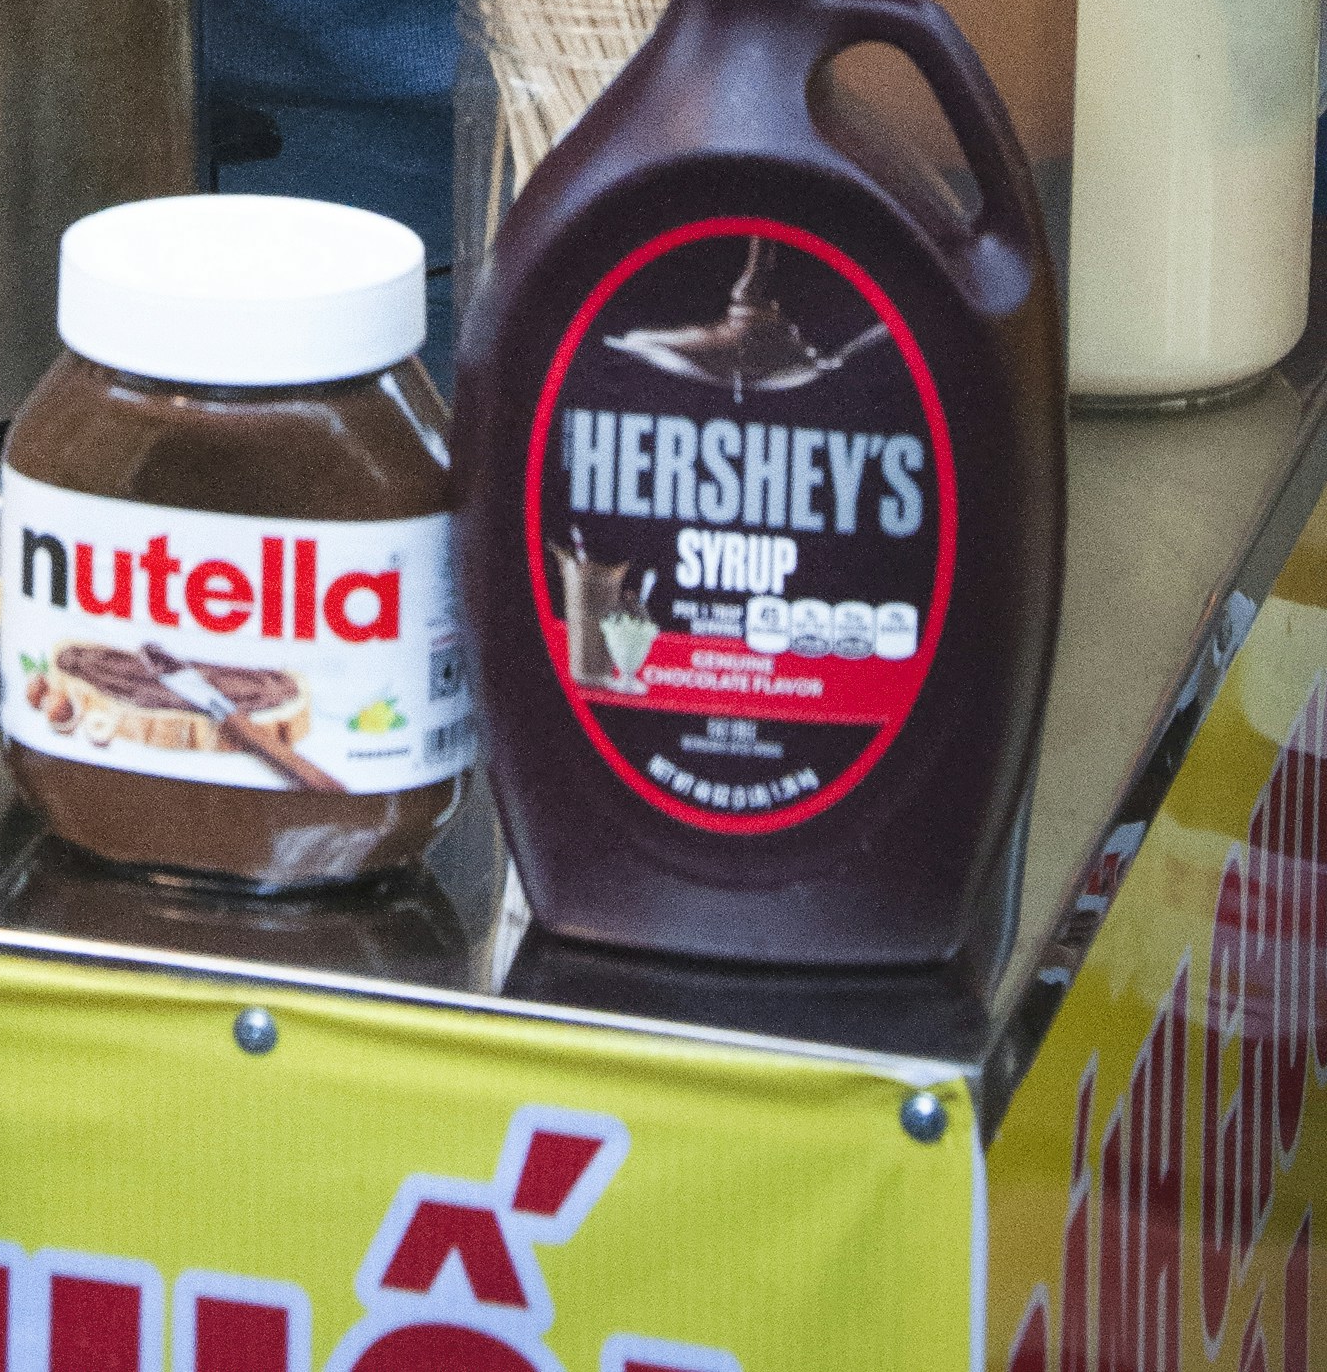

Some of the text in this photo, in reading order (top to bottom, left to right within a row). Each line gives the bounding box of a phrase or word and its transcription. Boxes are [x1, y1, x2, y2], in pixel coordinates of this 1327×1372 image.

[569, 409, 925, 538] HERSHEY'S
[20, 525, 403, 643] nutella
[675, 528, 799, 597] SYRUP
